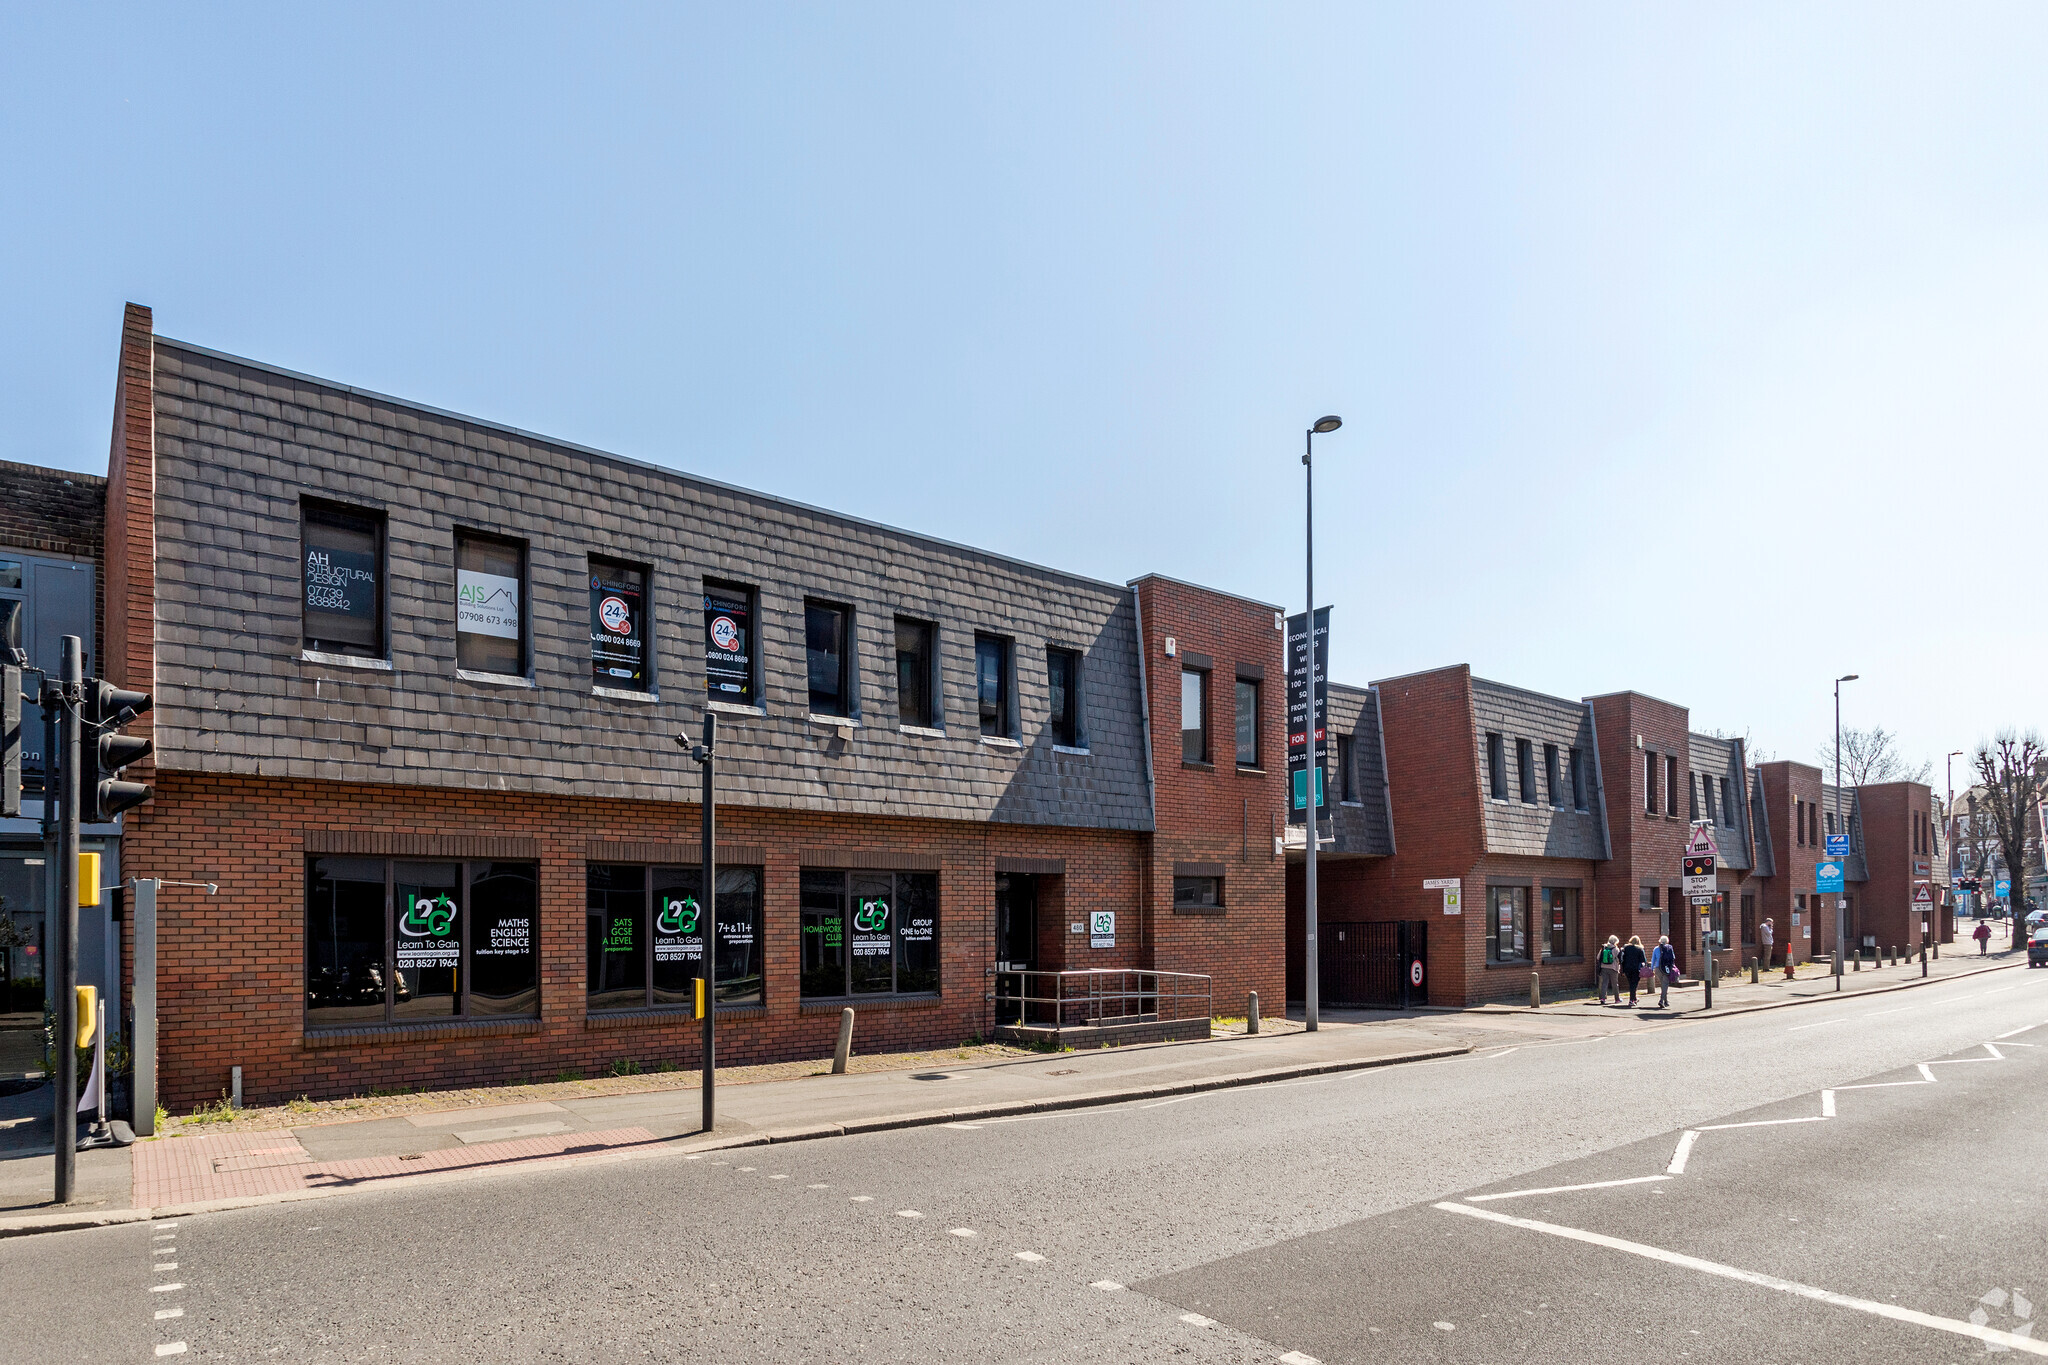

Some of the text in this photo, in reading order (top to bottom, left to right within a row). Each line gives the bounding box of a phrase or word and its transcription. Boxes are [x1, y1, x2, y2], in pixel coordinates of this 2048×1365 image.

[307, 551, 329, 565] AH
[307, 562, 375, 582] STRUCTURAL
[307, 571, 347, 587] DESIGN
[602, 579, 640, 592] CHINGFORD
[307, 585, 343, 599] 07739
[459, 584, 485, 603] AJS
[307, 595, 350, 610] 838842
[713, 599, 747, 612] CHINGFORD
[604, 604, 626, 619] 24/7
[459, 611, 518, 628] 07908 673 498
[716, 624, 734, 638] 24/7
[1289, 626, 1328, 642] ECONOICAL
[596, 633, 612, 643] 0800
[613, 636, 624, 646] 024
[1296, 640, 1319, 652] OFFES
[708, 652, 722, 660] 0800
[723, 654, 734, 662] 024
[1291, 680, 1302, 688] 100
[1299, 690, 1308, 698] SQ
[1290, 702, 1308, 712] FROM
[1294, 715, 1304, 724] PER
[1292, 734, 1305, 744] FOR
[408, 894, 450, 936] L2G
[663, 896, 696, 934] L2G
[860, 898, 886, 930] L2G
[498, 918, 529, 928] MATHS
[614, 918, 633, 926] SATS
[718, 922, 730, 933] 7+
[737, 922, 752, 932] 11+
[490, 928, 529, 938] ENGLISH
[611, 928, 632, 936] GCSE
[803, 926, 842, 934] HOMEWORK
[900, 928, 914, 936] ONE
[398, 940, 460, 950] Learn To Gain
[491, 938, 529, 948] SCIENCE
[602, 937, 633, 945] A LEVEL
[656, 936, 675, 944] Learn
[656, 952, 702, 961] 020 8527 1964
[398, 959, 458, 968] 020 8527 1964
[1414, 967, 1420, 980] 5
